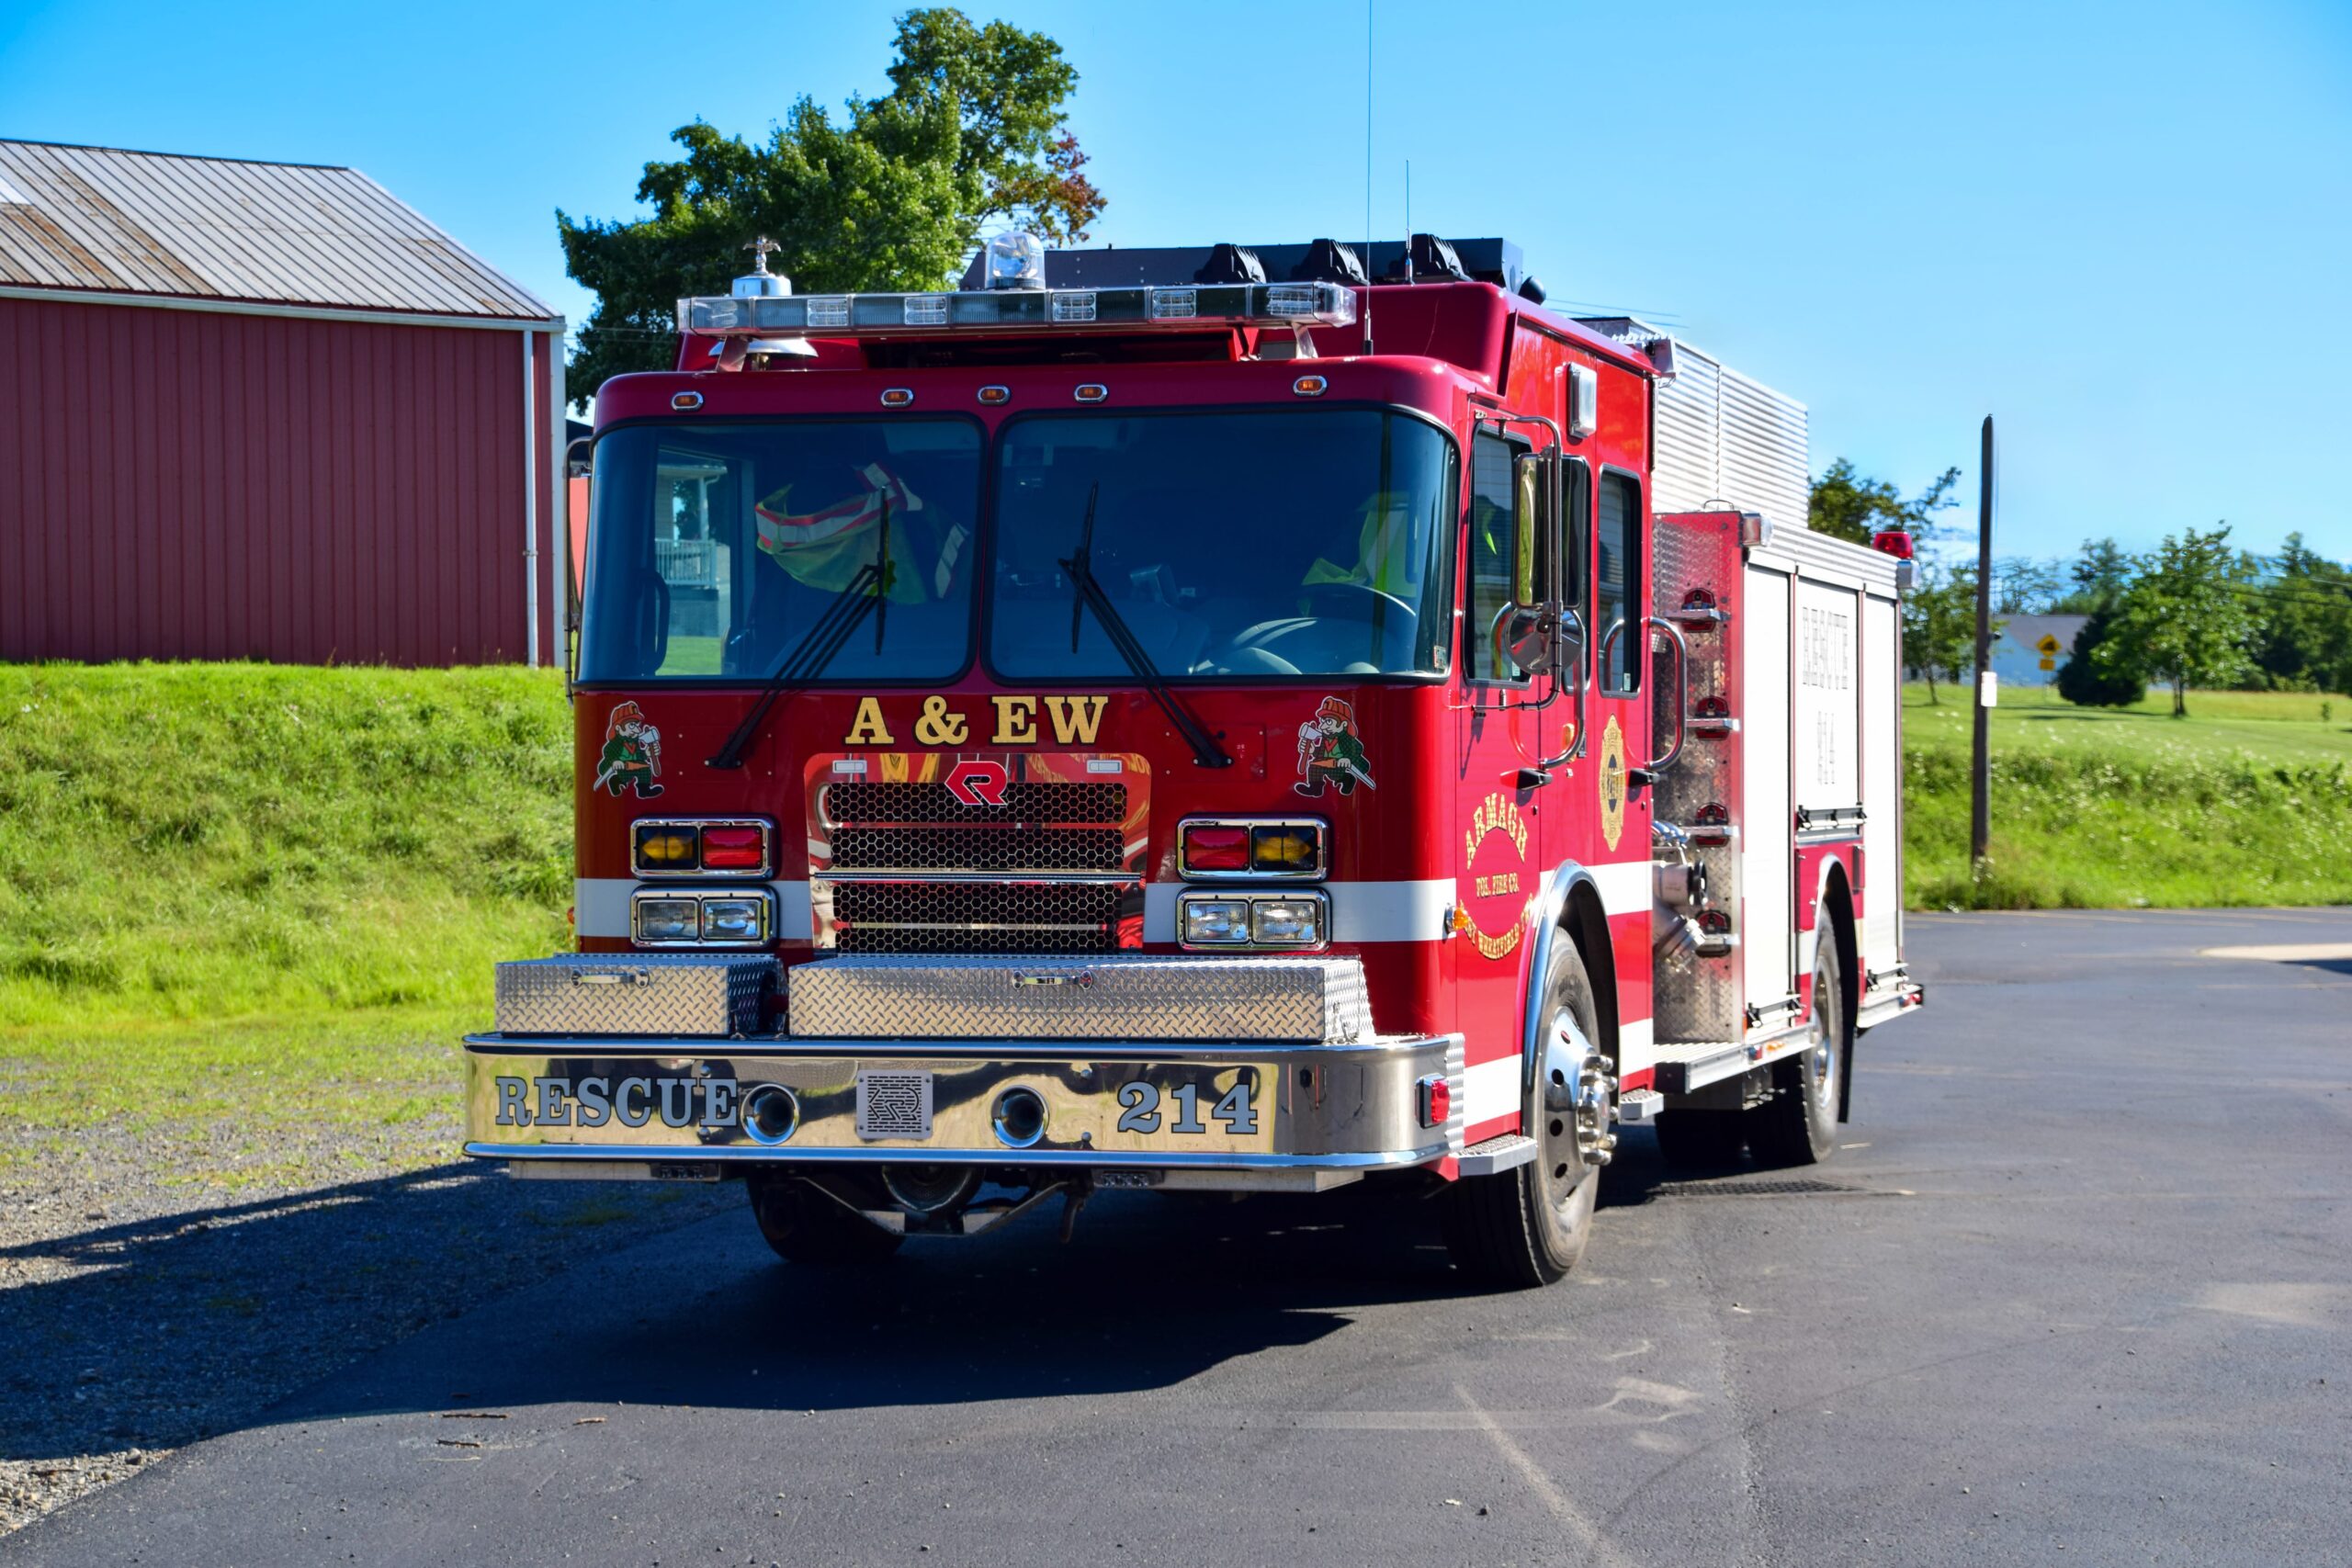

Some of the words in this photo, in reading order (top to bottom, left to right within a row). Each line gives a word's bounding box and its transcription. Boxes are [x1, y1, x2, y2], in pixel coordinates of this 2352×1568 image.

[1802, 605, 1849, 691] RESCUE
[844, 695, 896, 746] A
[914, 694, 970, 746] &
[990, 694, 1110, 745] EW
[1464, 792, 1529, 871] ARMAGH
[1492, 874, 1508, 896] FIRE
[1477, 922, 1520, 960] WHEATFIELD
[494, 1076, 738, 1128] RESCUE
[1116, 1080, 1259, 1135] 214
